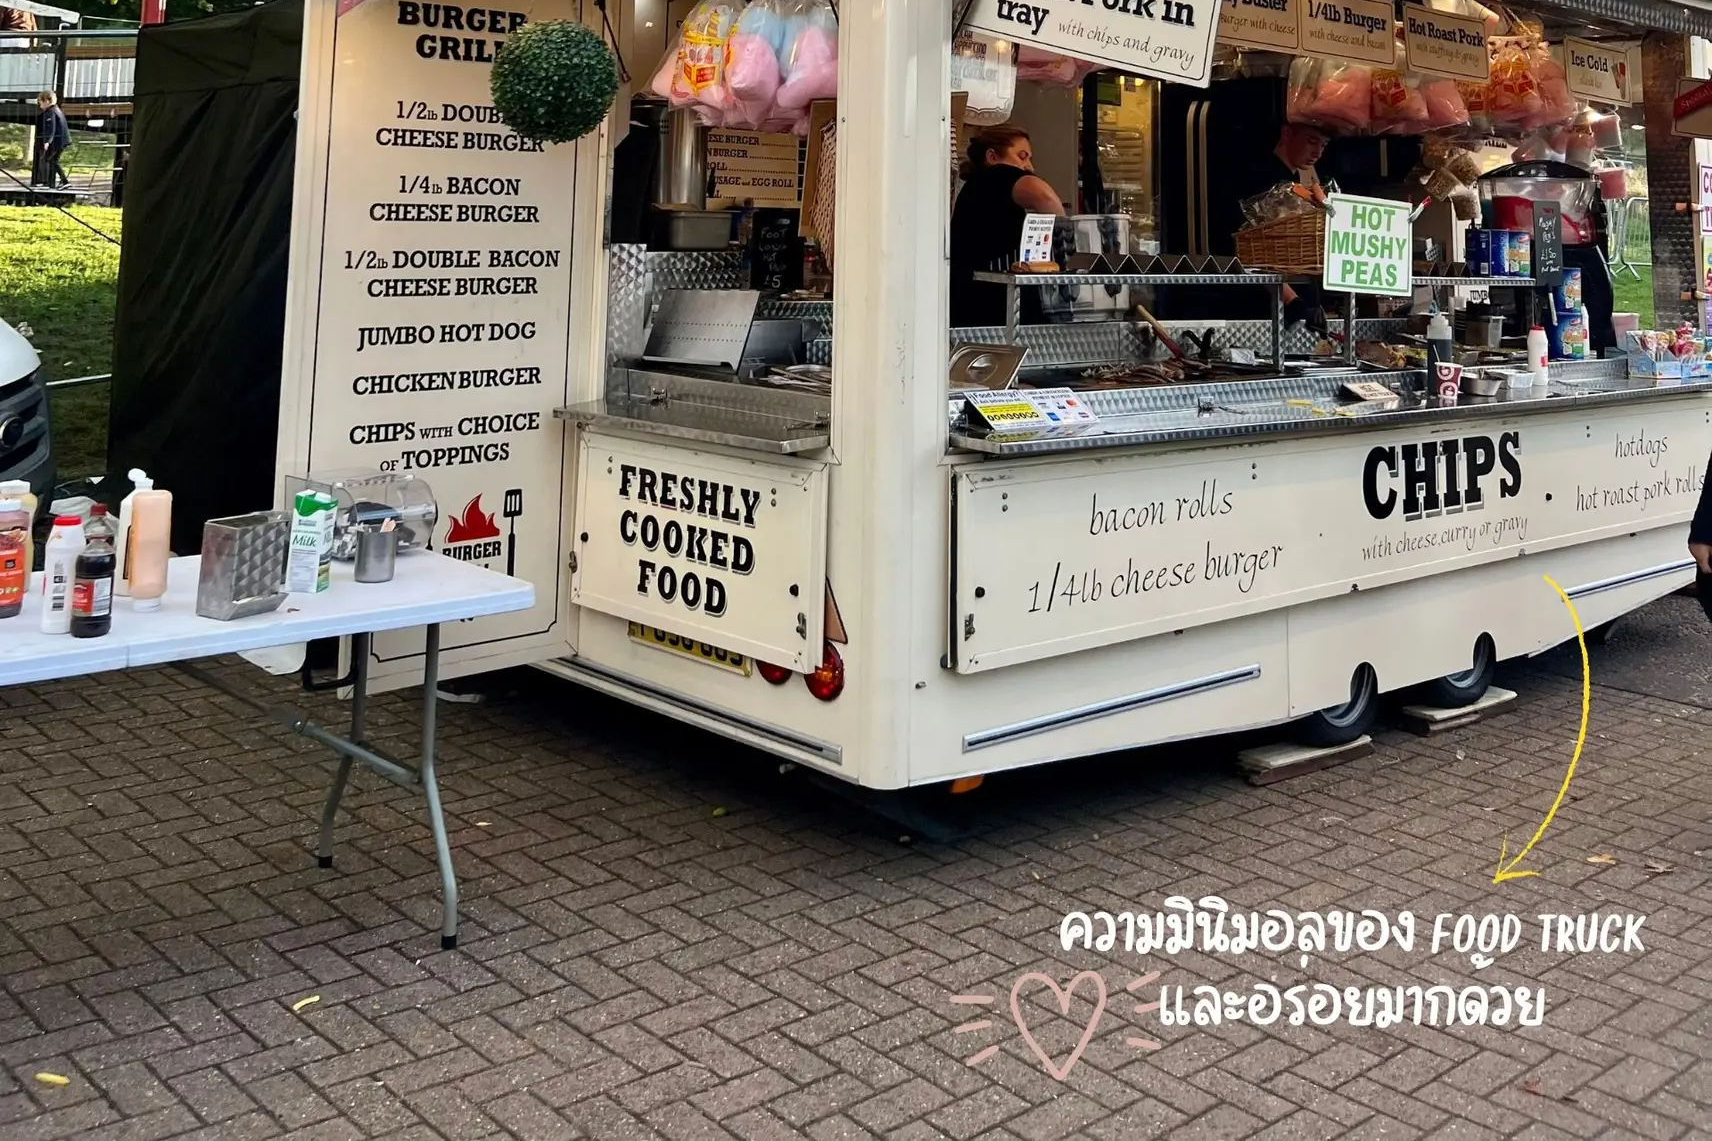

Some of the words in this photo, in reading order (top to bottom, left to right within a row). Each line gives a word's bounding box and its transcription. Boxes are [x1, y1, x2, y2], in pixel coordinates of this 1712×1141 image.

[397, 0, 529, 34] BURGER
[1250, 16, 1267, 30] with
[1269, 19, 1296, 35] cheese
[1308, 0, 1341, 23] 1/4lb
[1343, 6, 1387, 33] Burger
[1058, 19, 1084, 38] with
[1087, 25, 1120, 48] chips
[1123, 34, 1150, 54] and
[1150, 44, 1195, 70] gravy
[1309, 27, 1325, 39] with
[1326, 30, 1349, 43] cheese
[1350, 33, 1365, 46] and
[1366, 36, 1386, 50] bacon
[1408, 17, 1427, 36] Hot
[1428, 21, 1458, 43] Roast
[1459, 28, 1485, 48] Pork
[1571, 50, 1585, 67] Ice
[1587, 55, 1608, 73] Cold
[441, 104, 505, 124] DOUB
[376, 128, 458, 148] CHEESE
[462, 133, 545, 153] BURGER
[708, 134, 724, 144] ESE
[725, 135, 760, 146] BURGER
[713, 148, 748, 159] BURGER
[446, 177, 521, 196] BACON
[715, 176, 741, 186] USAGE
[752, 177, 771, 187] EGG
[772, 178, 794, 188] ROLL
[369, 203, 453, 222] CHEESE
[456, 205, 540, 223] BURGER
[1351, 204, 1396, 232] HOT
[392, 250, 481, 268] DOUBLE
[488, 250, 560, 268] BACON
[1331, 230, 1407, 261] MUSHY
[367, 278, 451, 298] CHEESE
[455, 277, 538, 296] BURGER
[1340, 259, 1398, 288] PEAS
[1469, 289, 1489, 301] JUMB
[357, 325, 435, 351] JUMBO
[439, 324, 485, 343] HOT
[488, 322, 536, 341] DOG
[352, 371, 456, 395] CHICKEN
[458, 367, 541, 389] BURGER
[349, 422, 415, 445] CHIPS
[419, 426, 453, 439] WITH
[458, 412, 540, 436] CHOICE
[380, 459, 399, 471] OF
[401, 442, 510, 470] TOPPINGS
[1615, 428, 1668, 468] hotdogs
[1363, 431, 1521, 522] CHIPS
[1577, 485, 1598, 511] hot
[1603, 480, 1639, 506] roast
[1641, 470, 1671, 511] pork
[619, 464, 760, 527] FRESHLY
[1090, 493, 1166, 535] bacon
[1176, 479, 1233, 521] rolls
[292, 534, 317, 547] Milk
[442, 541, 502, 561] BURGER
[620, 509, 755, 575] COOKED
[1362, 536, 1392, 560] with
[1479, 521, 1491, 536] or
[1493, 515, 1528, 544] gravy
[637, 559, 728, 617] FOOD
[1028, 561, 1102, 613] 1/4lb
[1111, 558, 1196, 597] cheese
[1204, 541, 1283, 594] burger
